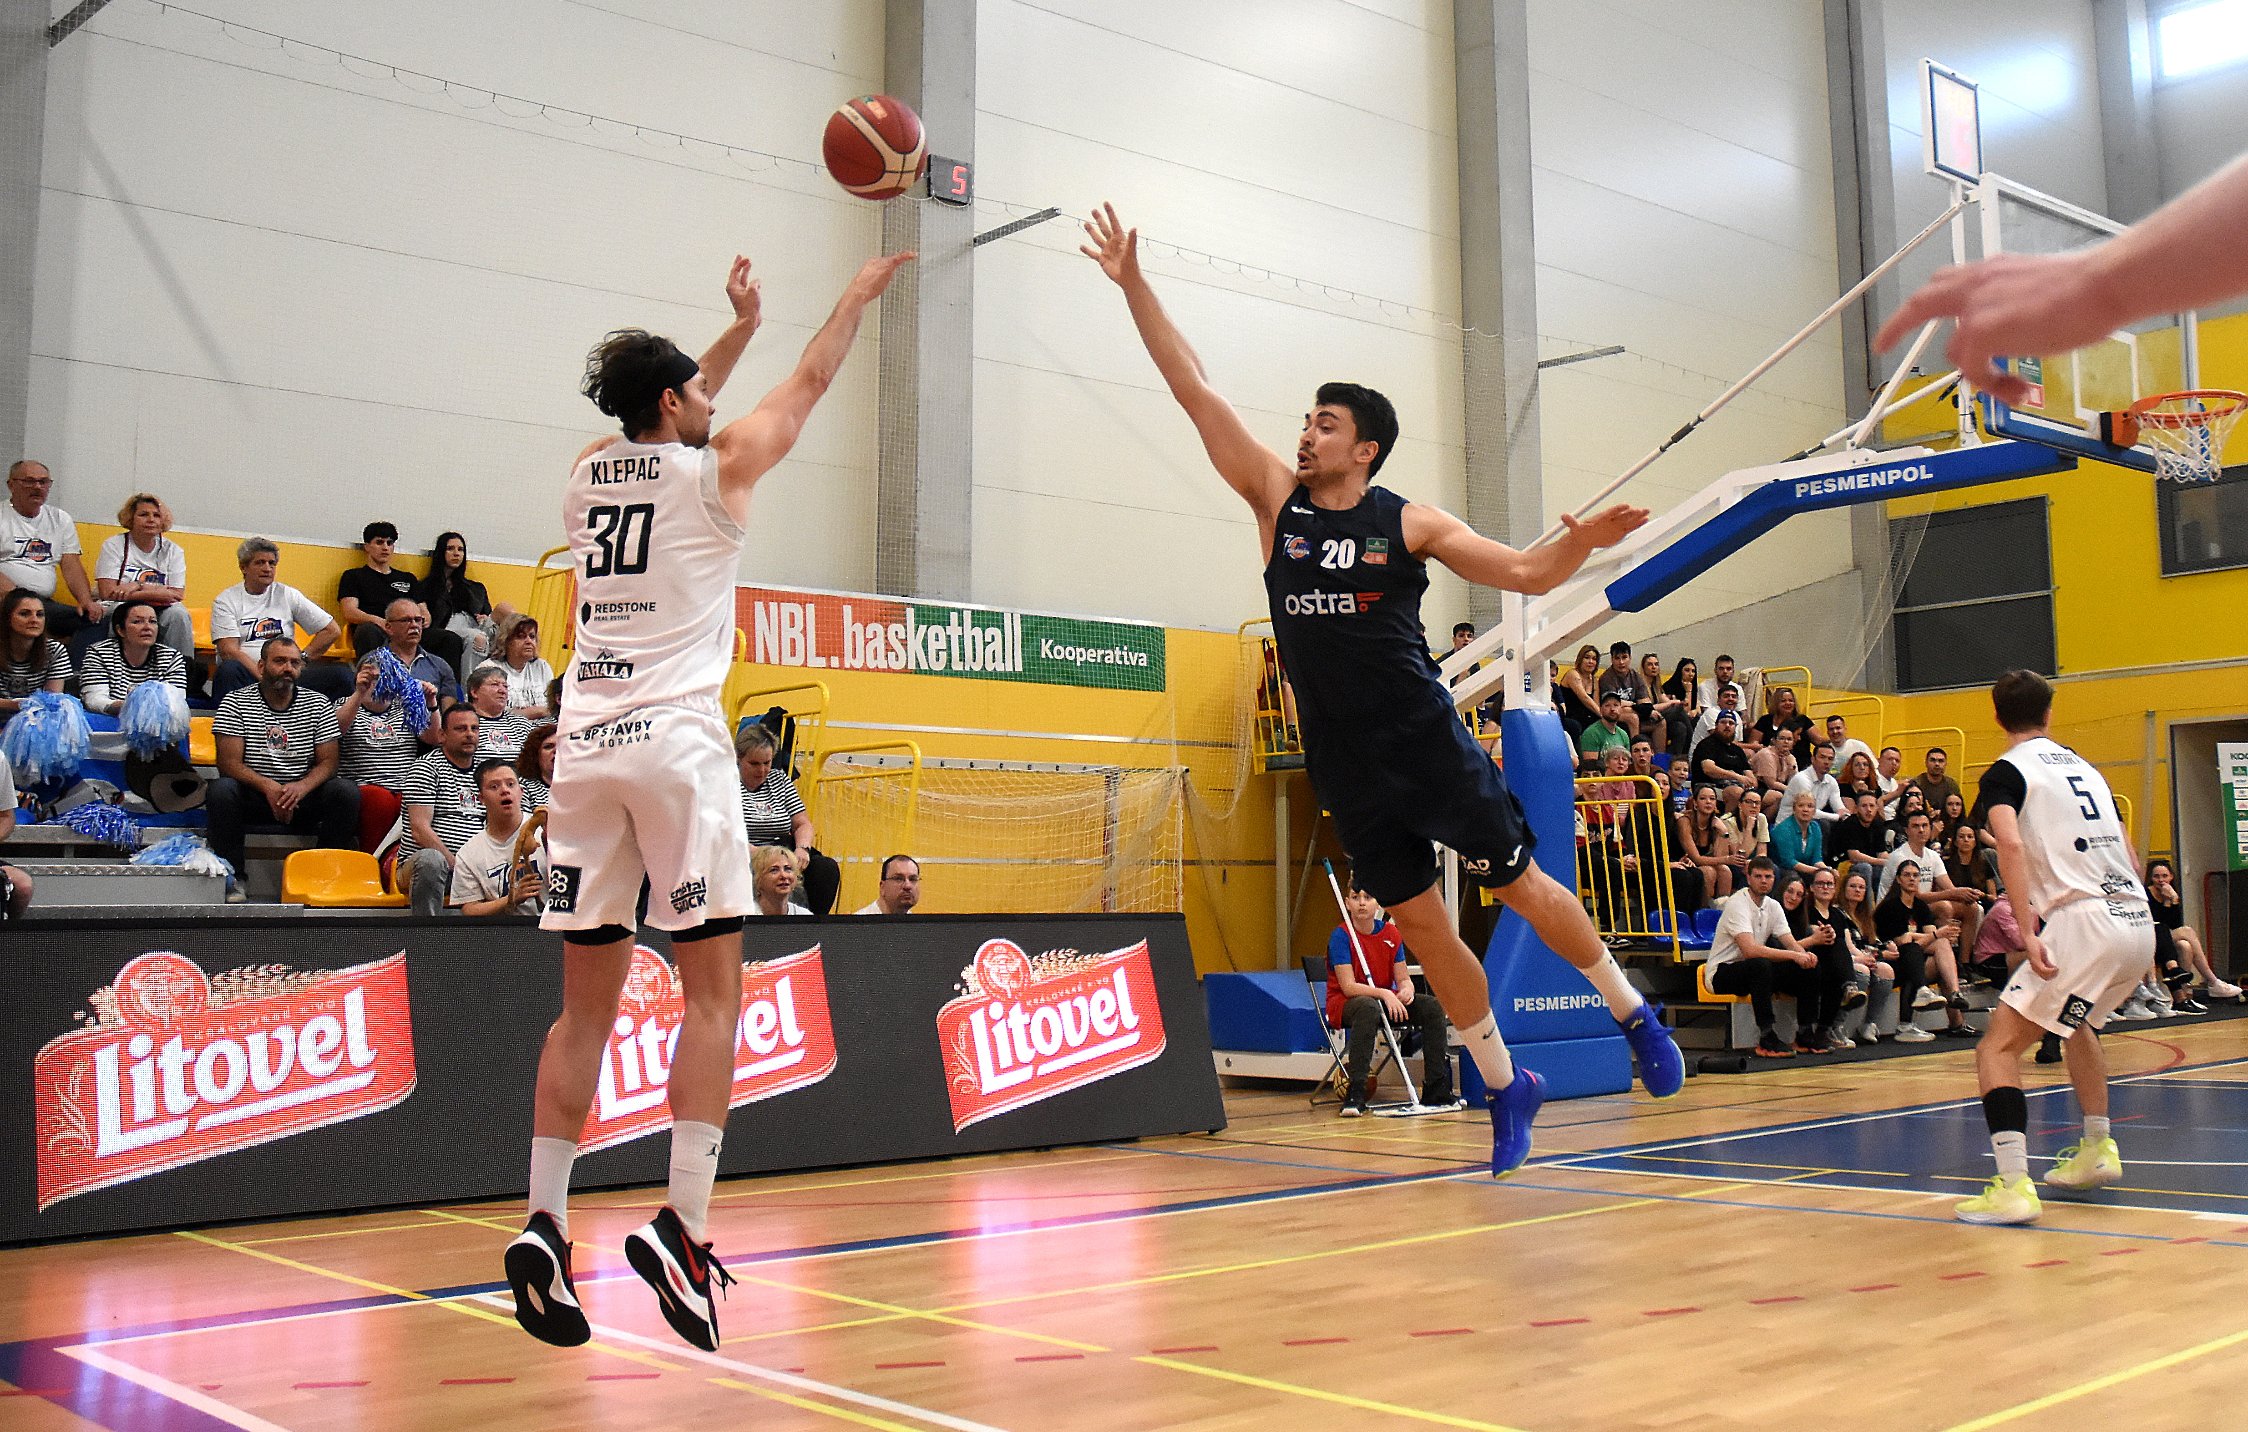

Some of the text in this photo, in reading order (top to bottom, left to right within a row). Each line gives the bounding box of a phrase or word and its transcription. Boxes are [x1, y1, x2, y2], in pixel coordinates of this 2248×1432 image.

[951, 165, 967, 196] 5
[1795, 464, 1934, 498] PESMENPOL
[585, 502, 655, 579] 30
[1320, 538, 1356, 570] 20
[594, 601, 656, 614] REDSTONE
[754, 600, 1023, 673] NBL.basketball
[1040, 638, 1148, 668] Kooperativa
[599, 732, 651, 748] MORAVA
[2066, 775, 2100, 821] 5
[598, 975, 806, 1122] Litel
[970, 966, 1140, 1096] Litovel
[94, 986, 378, 1158] Litovel
